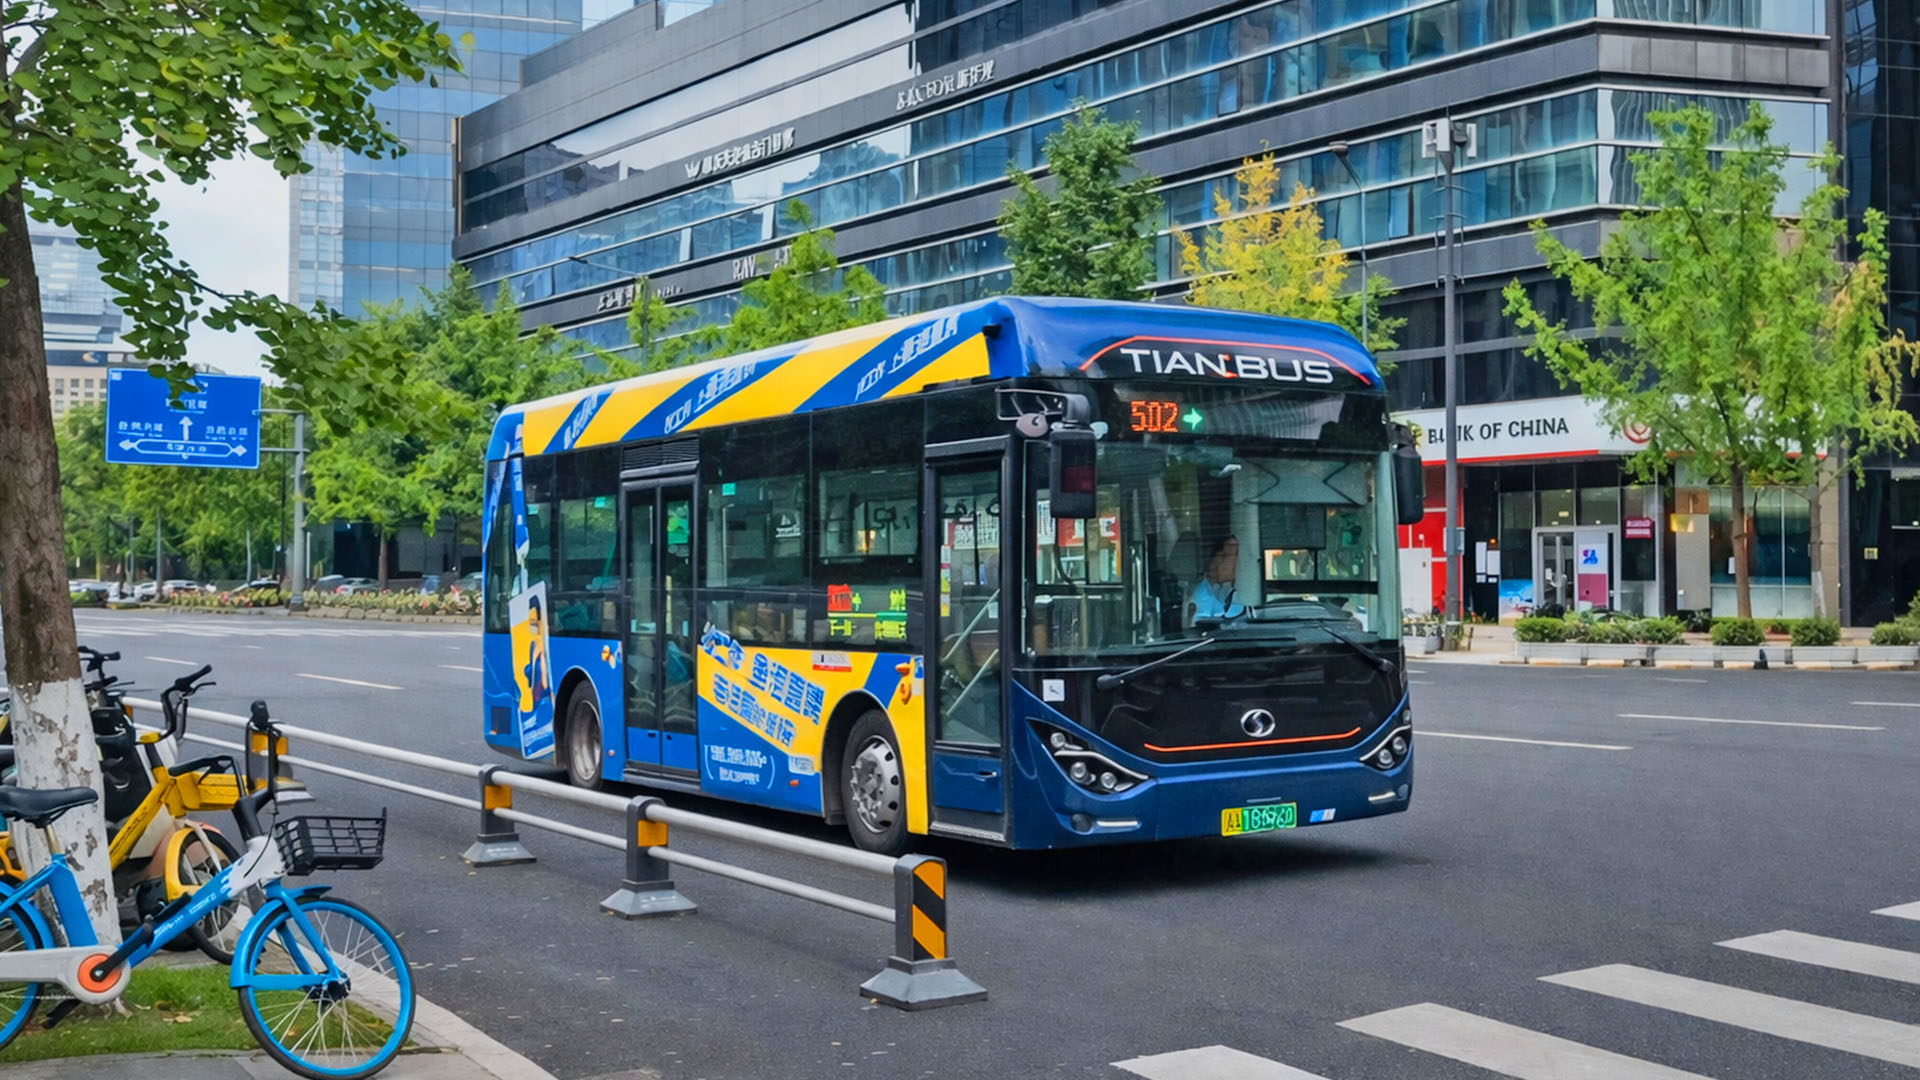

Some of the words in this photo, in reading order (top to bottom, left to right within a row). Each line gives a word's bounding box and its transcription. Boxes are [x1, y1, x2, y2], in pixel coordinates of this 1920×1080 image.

[1234, 354, 1334, 384] BUS
[1130, 400, 1179, 433] 502
[1479, 422, 1503, 440] OF
[1508, 417, 1569, 438] CHINA
